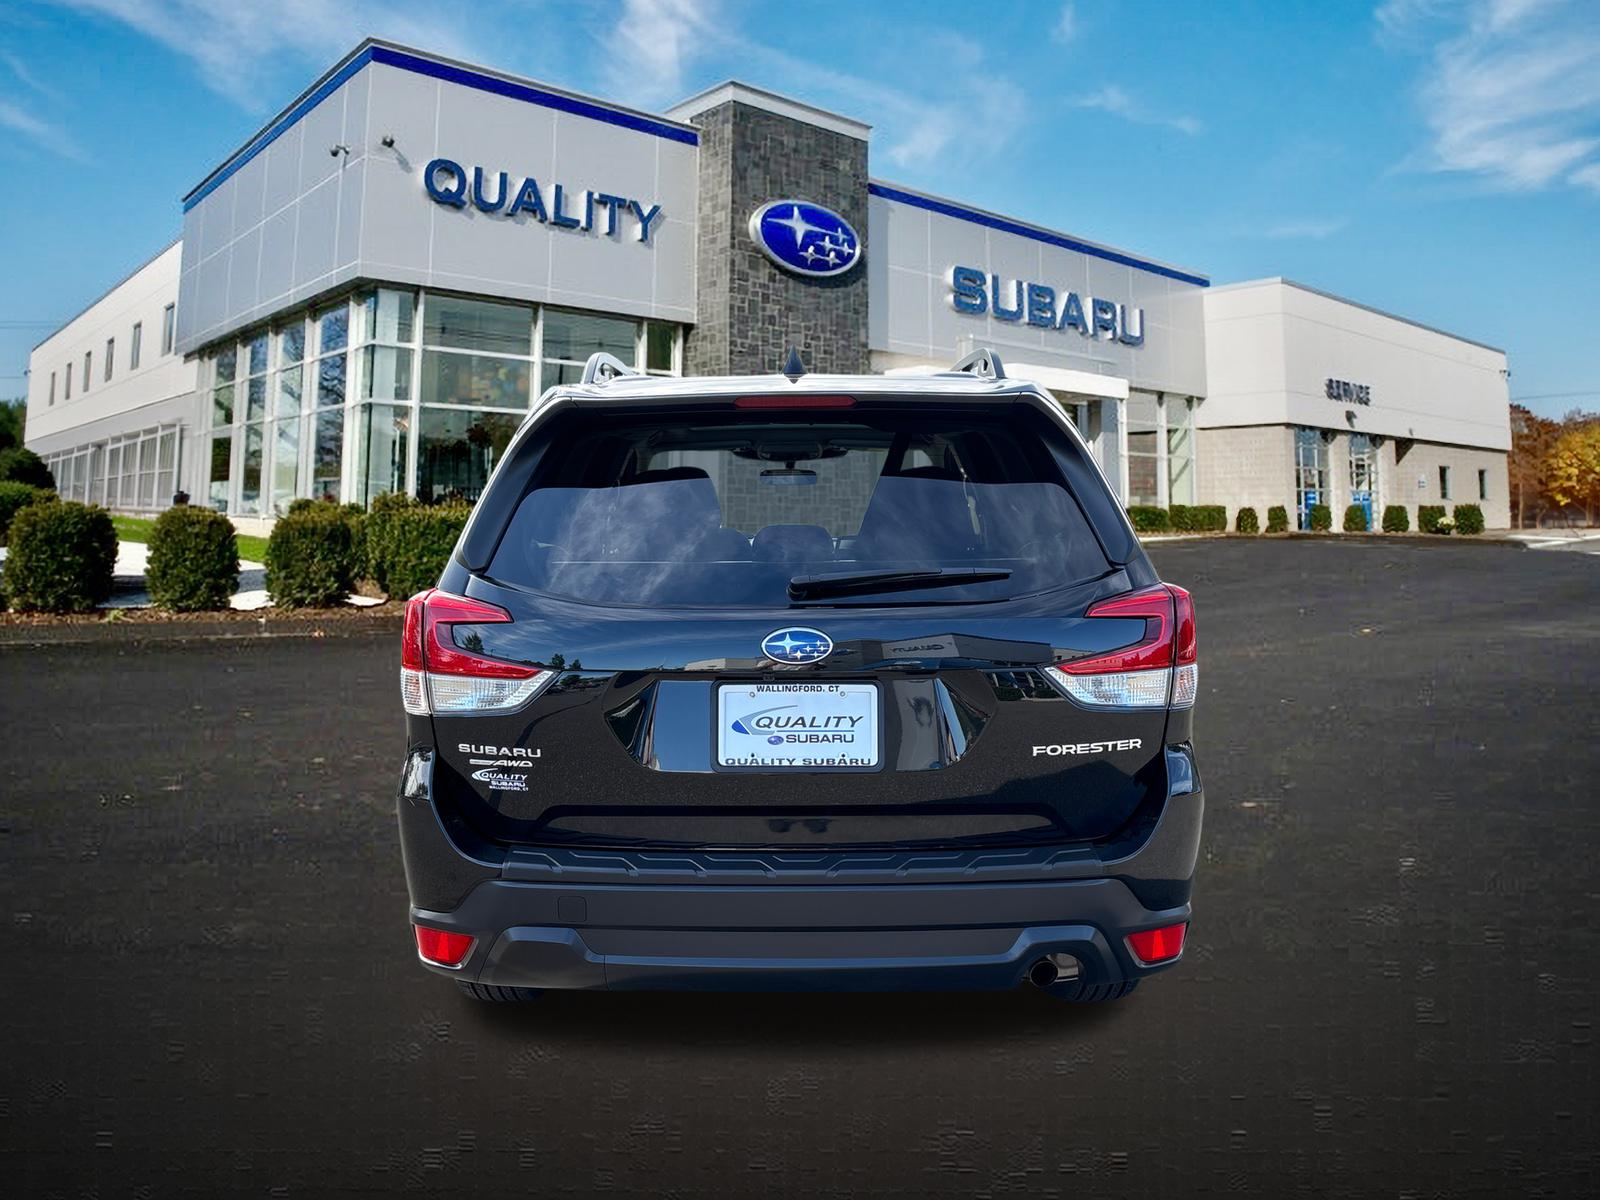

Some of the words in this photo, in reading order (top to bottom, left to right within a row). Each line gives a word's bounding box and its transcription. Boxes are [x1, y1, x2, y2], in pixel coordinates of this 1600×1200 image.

[424, 158, 661, 242] QUALITY
[950, 265, 1144, 346] SUBARU
[755, 716, 863, 729] QUALITY
[786, 734, 855, 743] SUBARU
[458, 743, 542, 757] SUBARU
[1032, 738, 1142, 756] FORESTER
[725, 758, 796, 766] QUALITY
[802, 758, 871, 766] SUBARU
[481, 772, 528, 780] QUALITY
